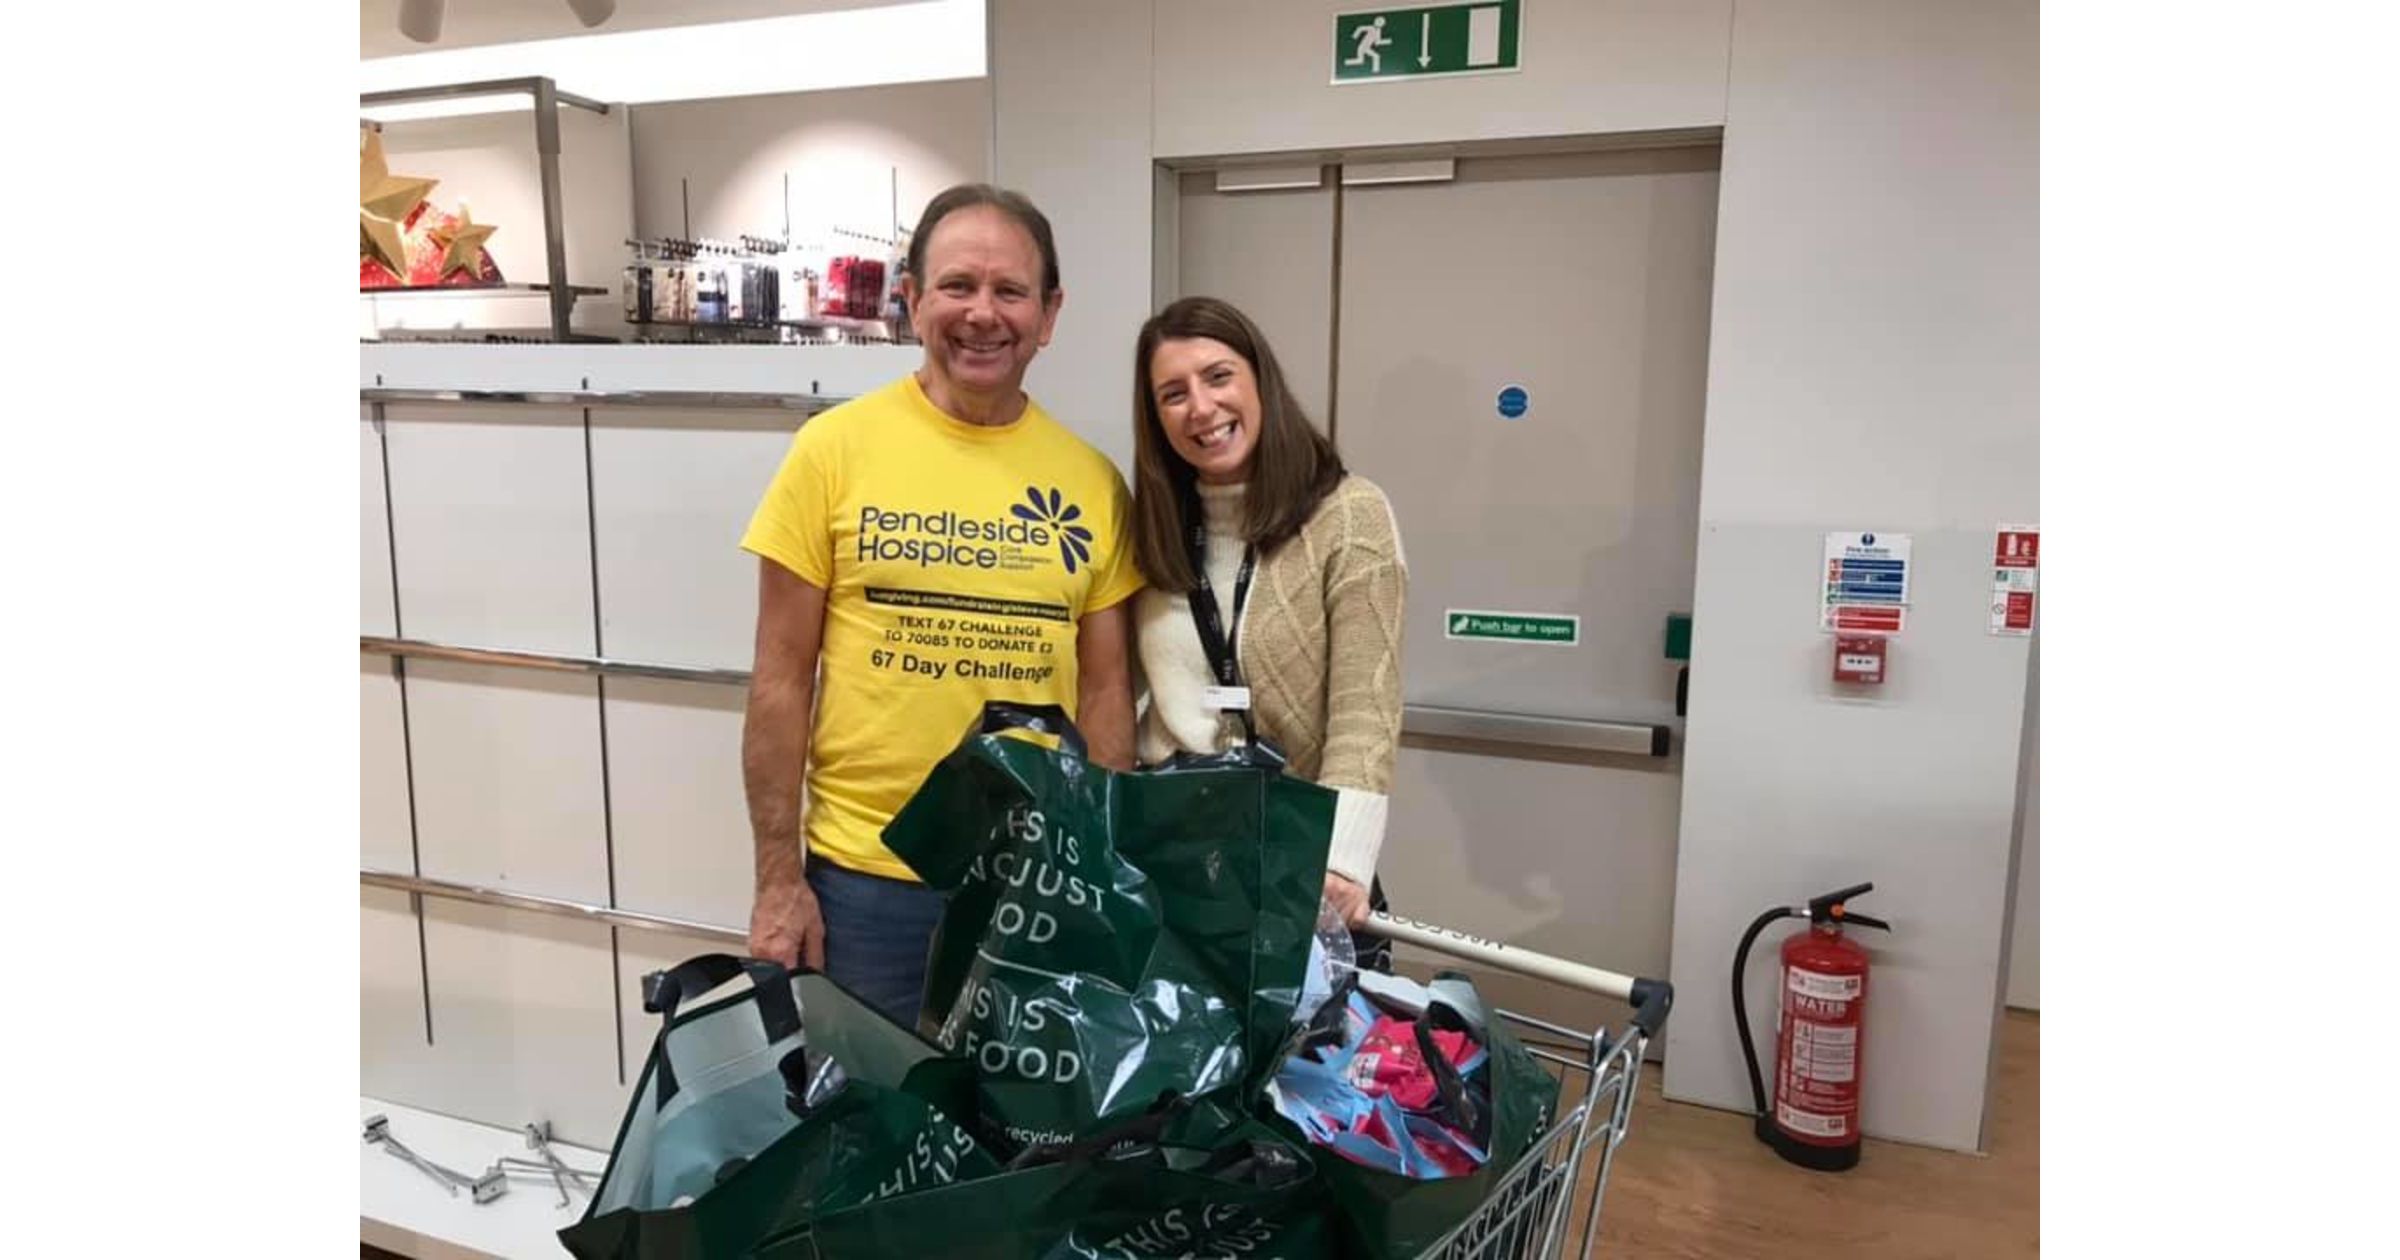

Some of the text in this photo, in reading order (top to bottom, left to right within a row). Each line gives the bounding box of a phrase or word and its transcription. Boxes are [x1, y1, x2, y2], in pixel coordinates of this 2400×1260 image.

[860, 506, 1050, 546] Pendleside
[858, 534, 998, 568] Hospice
[884, 629, 902, 642] TO
[954, 636, 975, 650] TO
[978, 638, 1035, 654] DONATE
[897, 615, 1043, 638] TEXT 67 CHALLENGE
[871, 649, 1054, 684] 67 Day Challenge
[1008, 858, 1105, 912] JUST
[1006, 994, 1047, 1032] IS
[1794, 994, 1847, 1017] WATER
[965, 1031, 1081, 1084] FOOD
